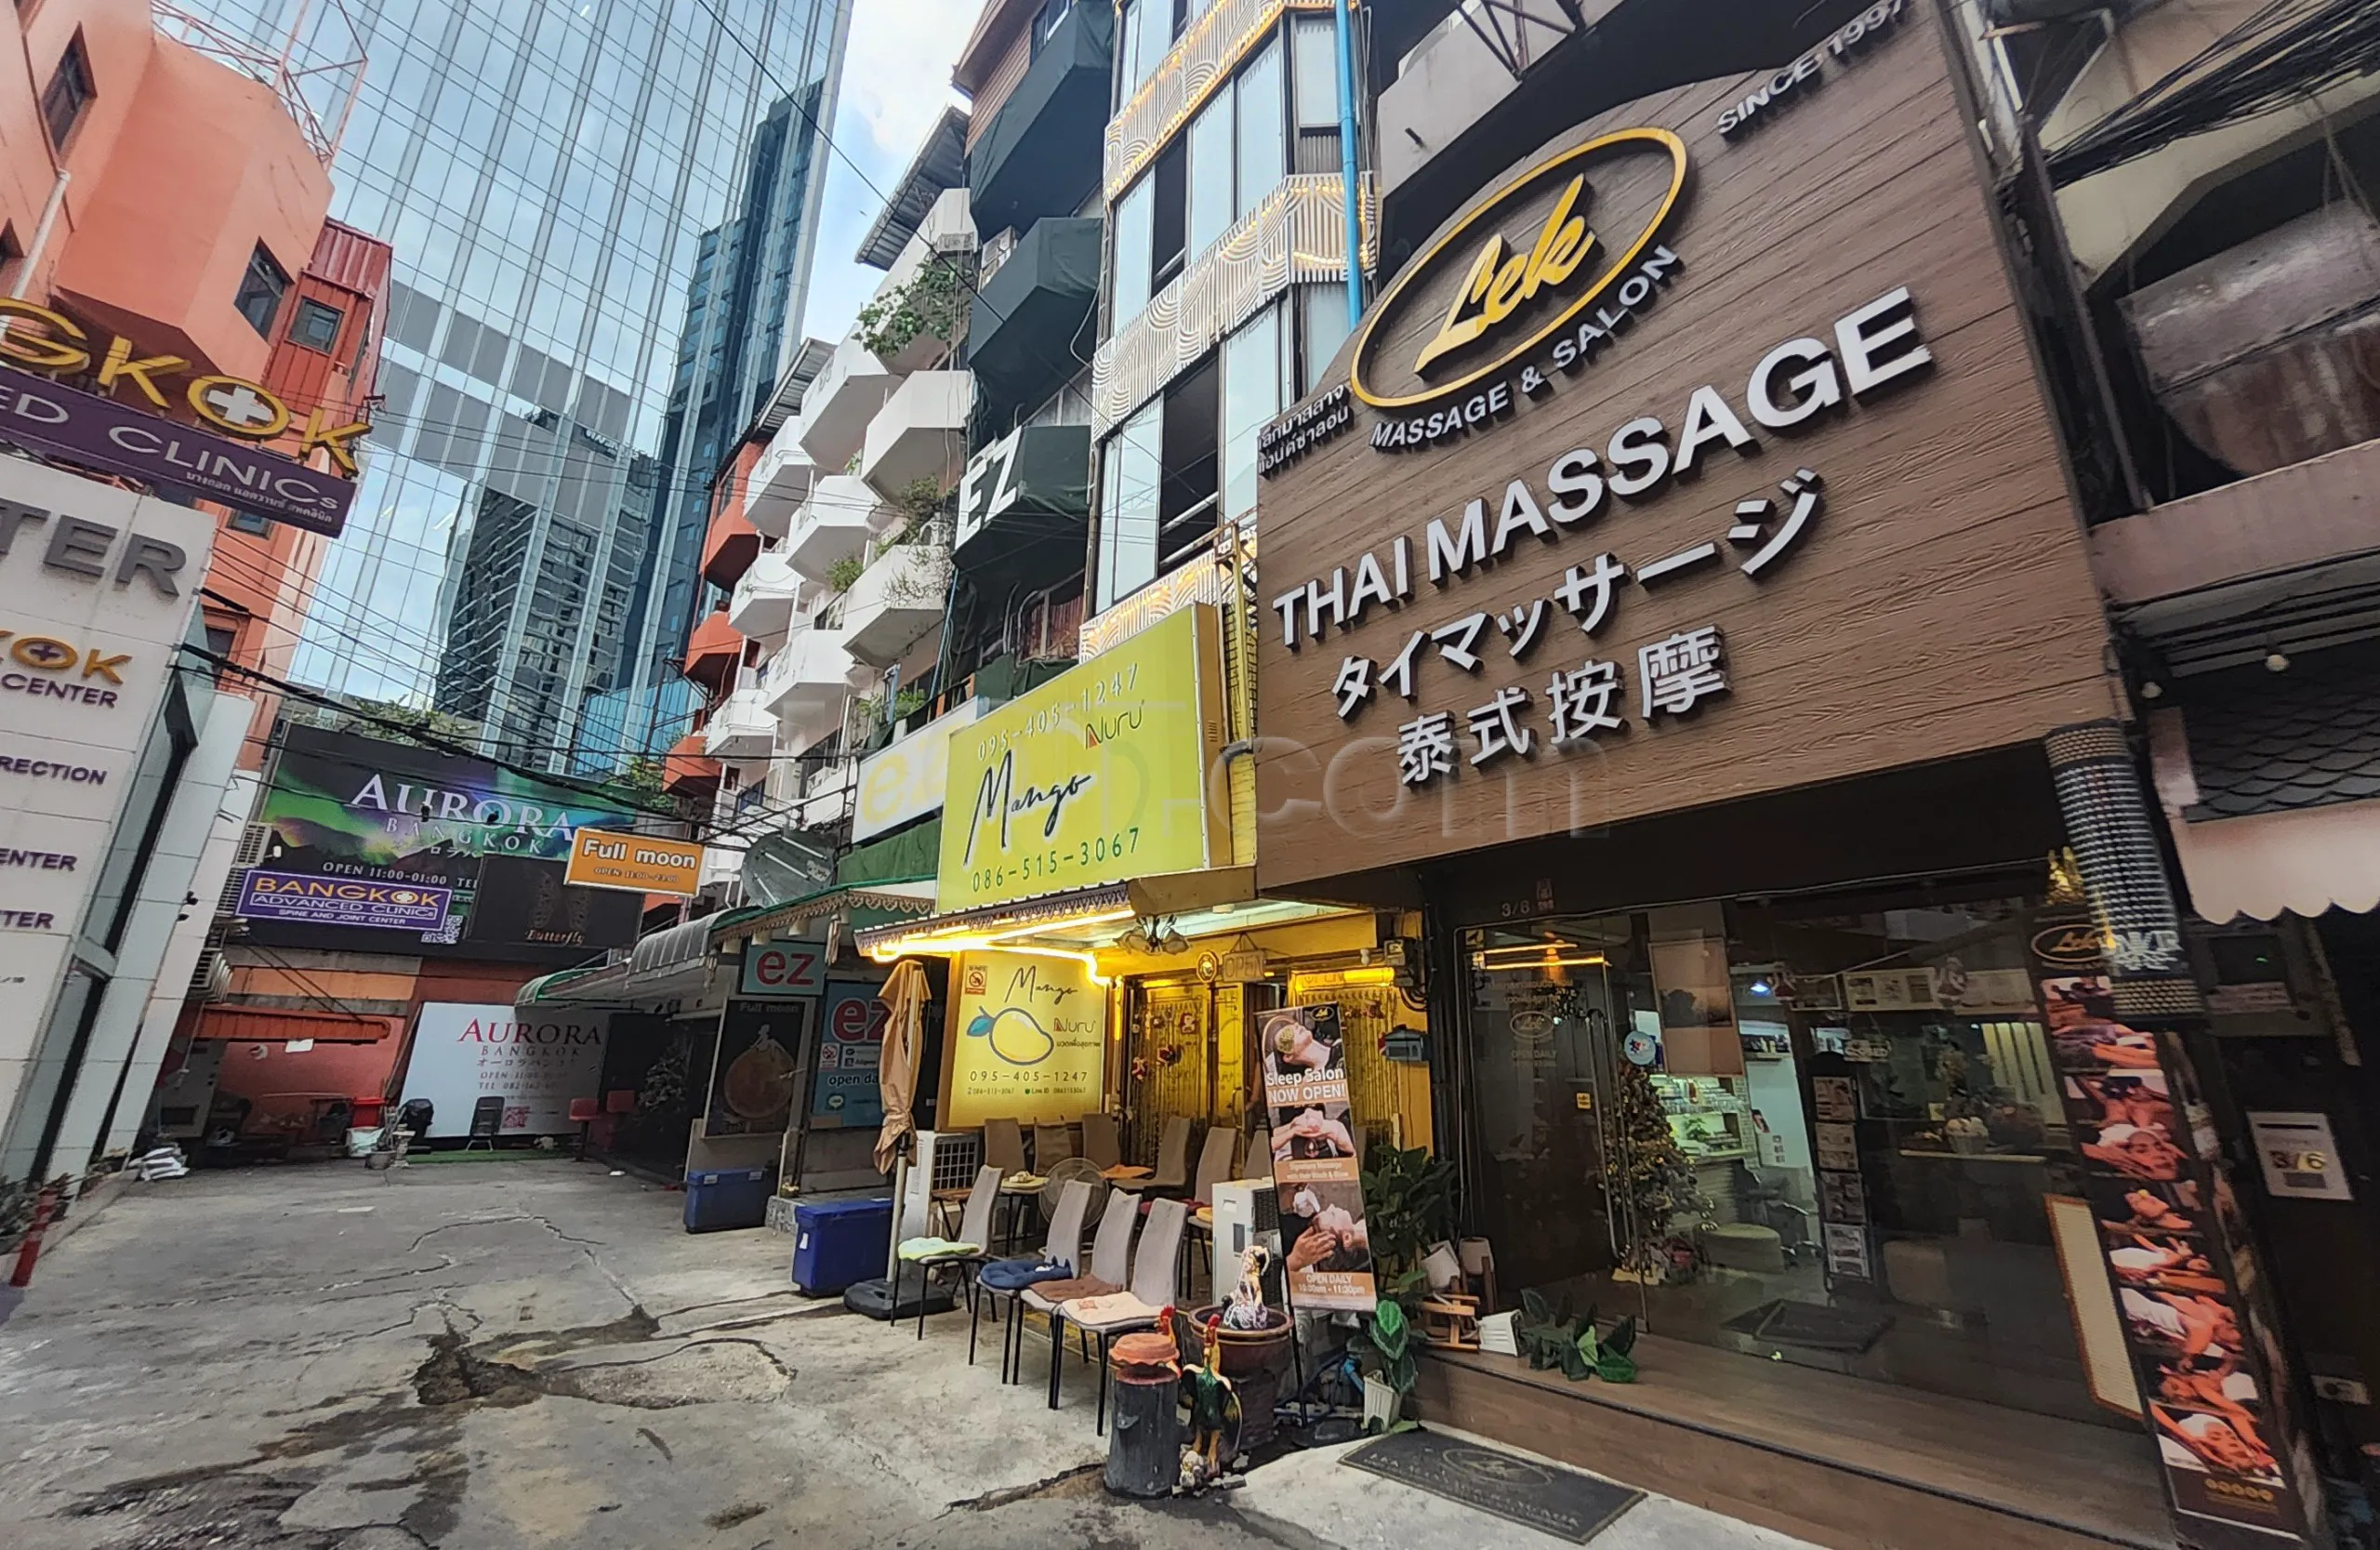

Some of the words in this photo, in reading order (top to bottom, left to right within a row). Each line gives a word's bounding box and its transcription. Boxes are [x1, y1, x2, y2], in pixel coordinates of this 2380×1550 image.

[1717, 53, 1824, 134] SINCE
[1414, 173, 1597, 372] Lek
[1368, 381, 1511, 448] MASSAGE
[1521, 365, 1546, 392] &
[1552, 245, 1680, 370] SALON
[1272, 535, 1415, 648] THAI
[1425, 287, 1933, 590] MASSAGE
[955, 425, 1023, 551] EZ
[1330, 469, 1827, 719] タイマッサージ
[0, 630, 134, 686] OK
[1, 673, 119, 708] CENTER
[1396, 625, 1731, 785] 泰式按摩
[977, 663, 1140, 762] 095-405-1247
[350, 773, 574, 841] AURORA
[962, 749, 1093, 868] Mango
[385, 817, 544, 854] BANGKOK
[582, 838, 628, 861] Full
[634, 848, 697, 870] moon
[323, 861, 365, 877] OPEN
[368, 866, 448, 886] 11:00-01:00
[971, 827, 1141, 894] 086-515-3067
[253, 894, 364, 912] ADVANCED
[254, 877, 443, 907] BANGKOK
[278, 908, 308, 918] SPINE
[310, 911, 335, 920] AND
[336, 913, 365, 922] JOINT
[368, 915, 406, 925] CENTER
[754, 947, 817, 987] ez
[1004, 965, 1079, 1006] Mango
[456, 1017, 602, 1046] AURORA
[481, 1044, 581, 1057] BANGKOK
[828, 1073, 861, 1087] open
[970, 1070, 1089, 1082] 095-405-1247
[1265, 1071, 1302, 1087] Sleep
[1304, 1066, 1344, 1084] Salon
[1268, 1086, 1300, 1104] NOW
[1302, 1082, 1346, 1101] OPEN!
